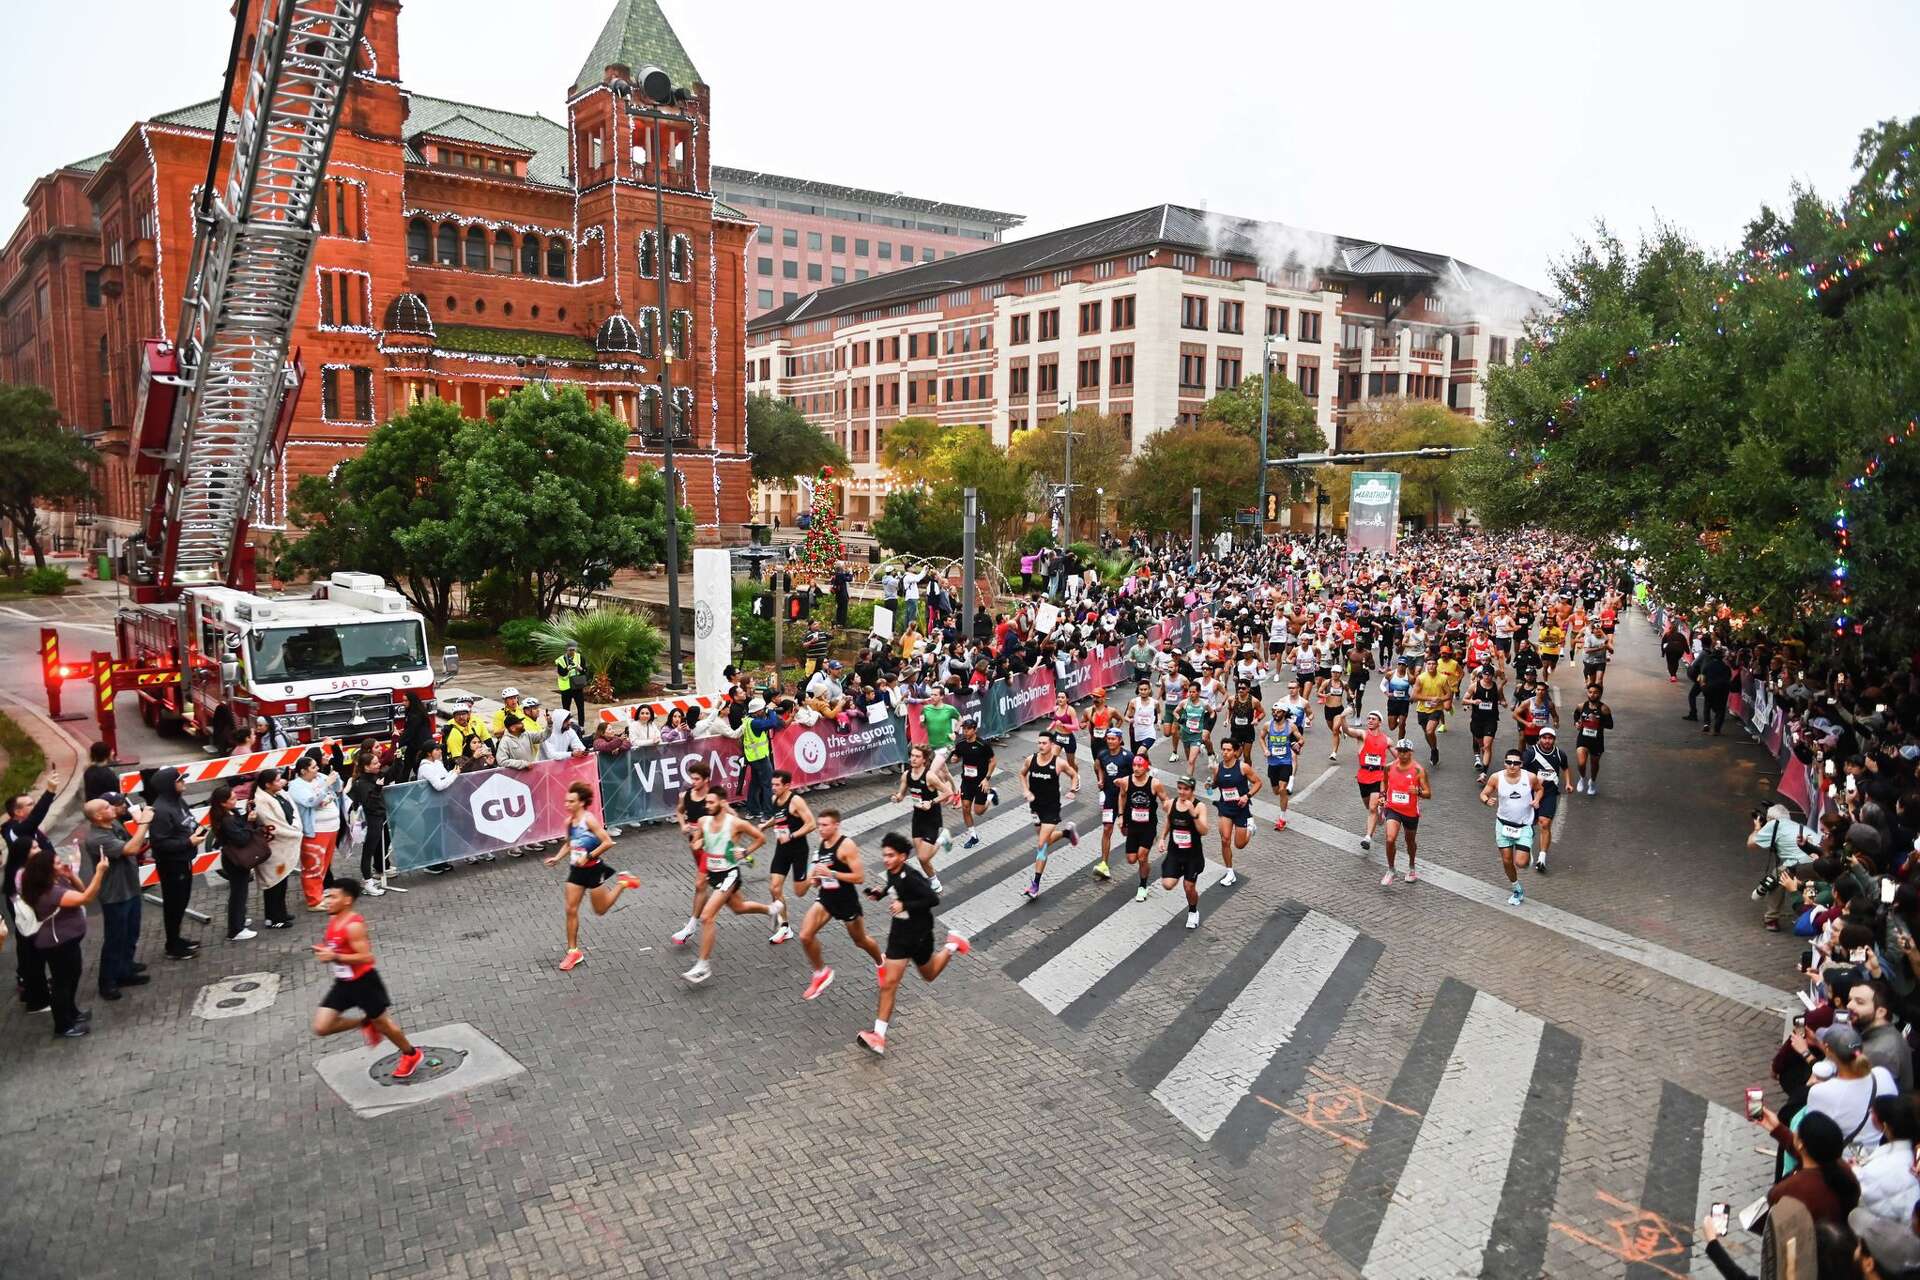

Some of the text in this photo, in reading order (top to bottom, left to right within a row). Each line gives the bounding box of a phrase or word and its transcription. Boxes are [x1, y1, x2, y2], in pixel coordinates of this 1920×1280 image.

[331, 678, 369, 690] SAFD
[827, 724, 895, 748] the ce group
[481, 794, 527, 821] GU
